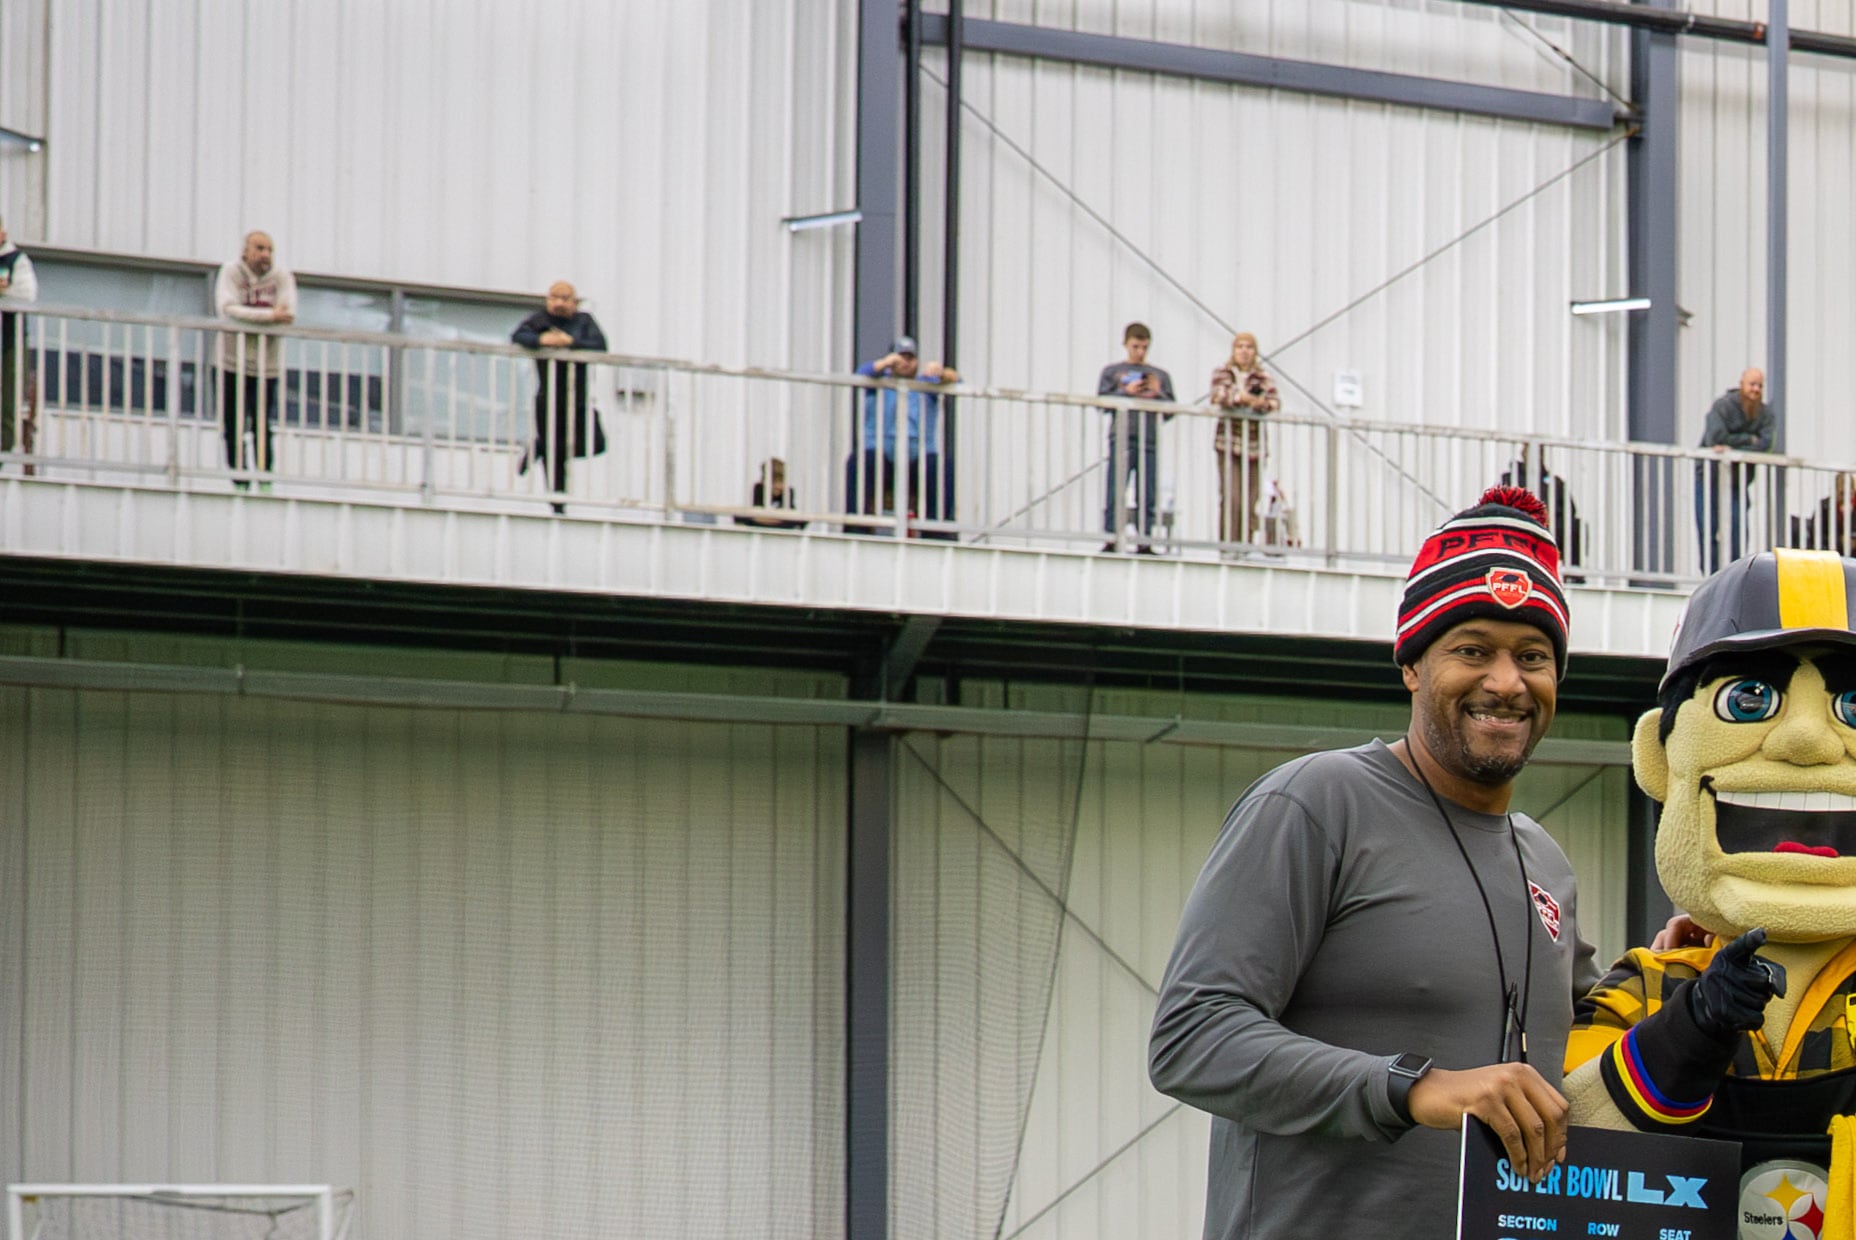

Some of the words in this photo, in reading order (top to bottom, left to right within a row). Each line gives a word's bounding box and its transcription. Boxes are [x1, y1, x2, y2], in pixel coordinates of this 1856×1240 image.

[1493, 582, 1527, 594] PFFL
[1566, 1165, 1623, 1200] BOWL
[1626, 1171, 1709, 1209] LX
[1498, 1215, 1557, 1231] SECTION
[1587, 1222, 1620, 1237] ROW
[1743, 1211, 1784, 1226] Steelers
